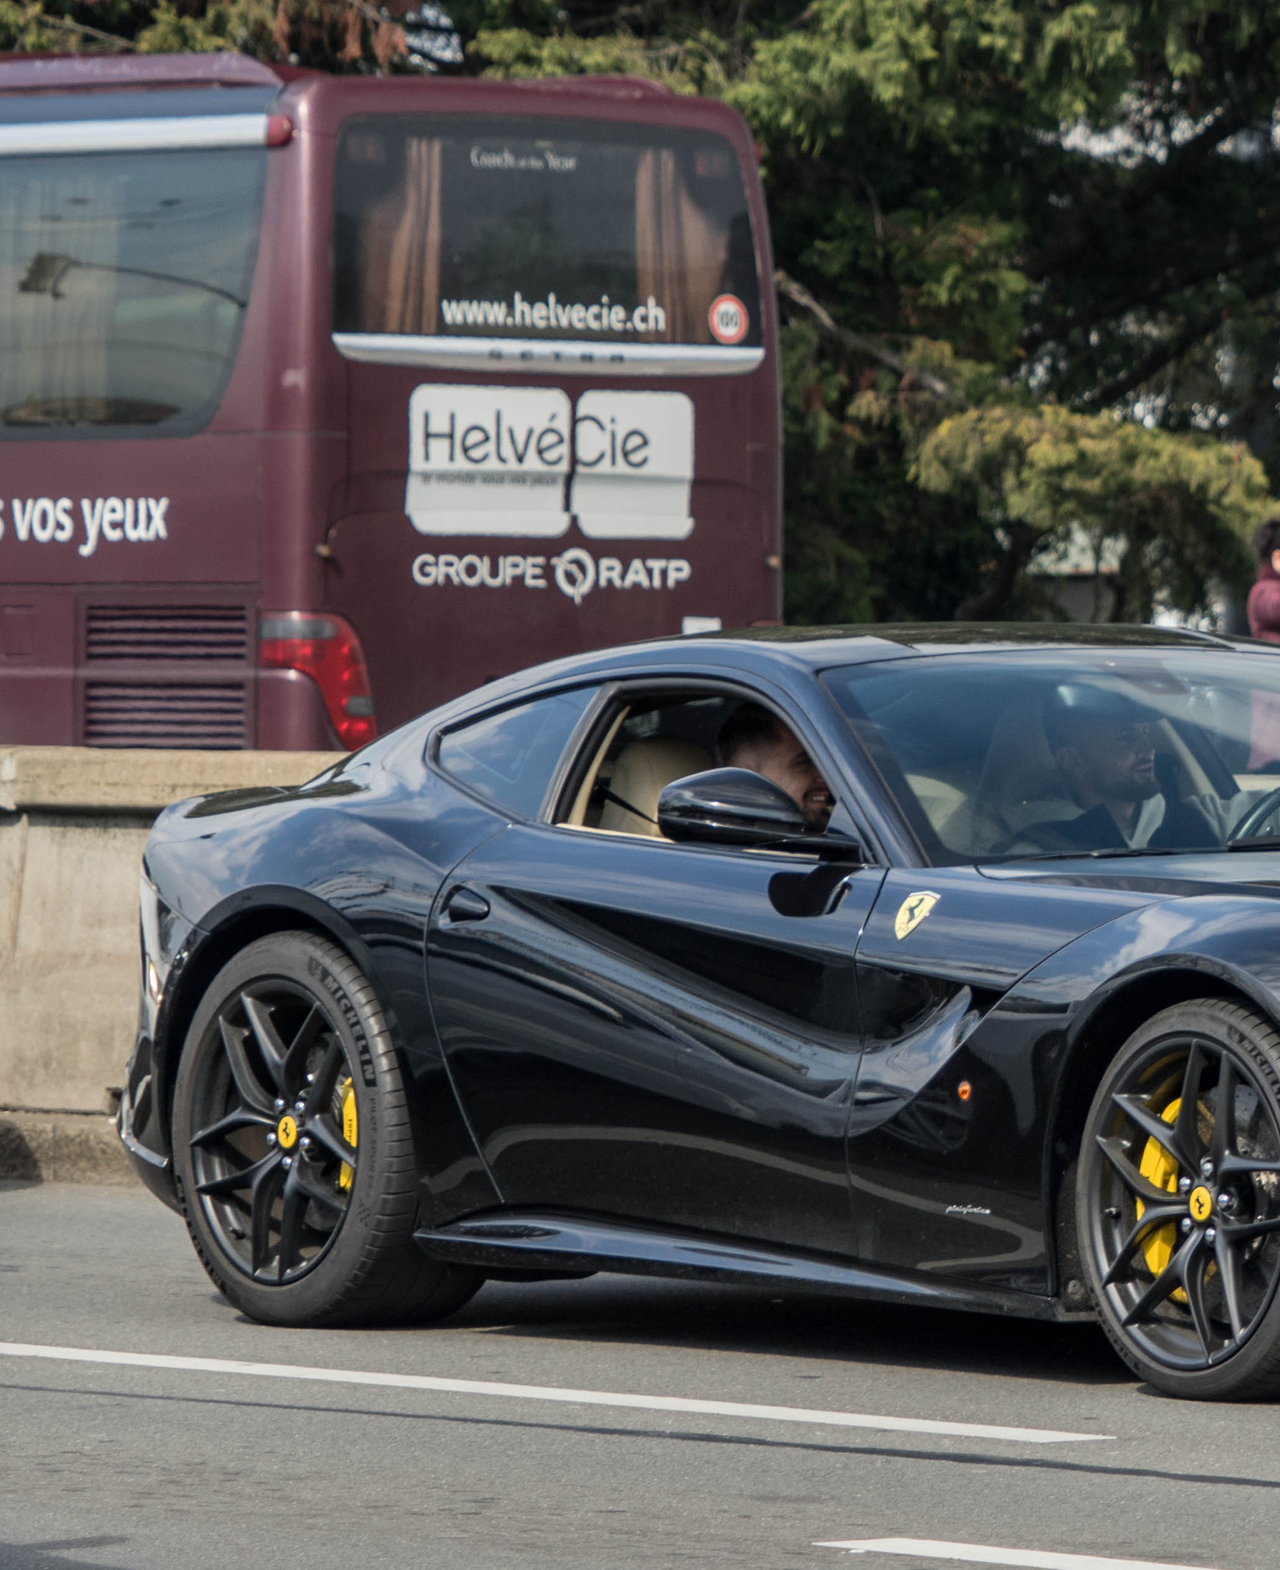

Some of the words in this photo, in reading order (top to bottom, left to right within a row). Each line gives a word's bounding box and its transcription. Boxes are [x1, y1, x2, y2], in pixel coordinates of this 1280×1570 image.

[441, 291, 666, 333] www.helvecie.ch
[11, 497, 74, 542] vos
[78, 496, 170, 557] yeux
[412, 553, 548, 588] GROUPE
[598, 557, 692, 589] RATP
[323, 973, 376, 1082] MICHELIN
